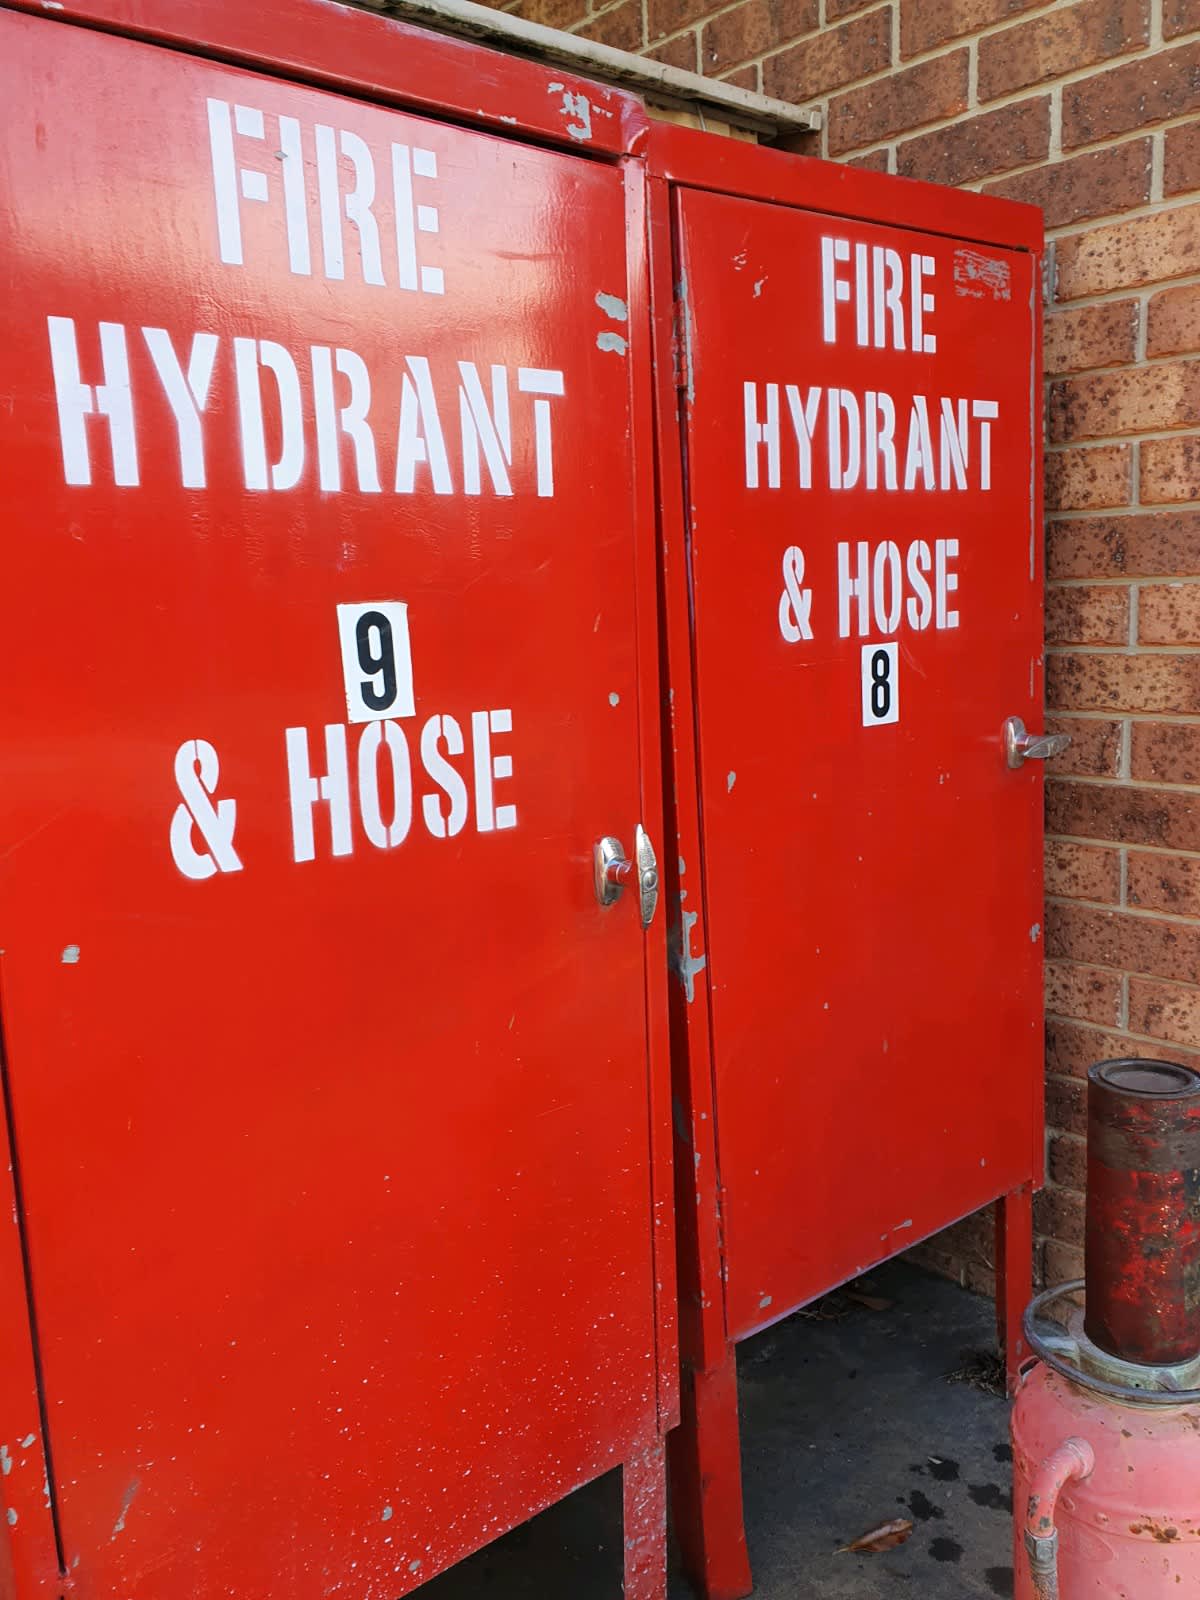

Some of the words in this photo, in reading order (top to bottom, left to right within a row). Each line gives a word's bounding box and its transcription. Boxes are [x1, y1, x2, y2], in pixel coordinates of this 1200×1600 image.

[206, 97, 446, 296] FIRE
[821, 236, 937, 354] FIRE
[47, 315, 565, 498] HYDRANT
[743, 381, 999, 491] HYDRANT
[778, 545, 814, 643] &
[837, 538, 959, 638] HOSE
[355, 611, 398, 711] 9
[871, 649, 891, 718] 8
[169, 738, 244, 880] &
[285, 708, 517, 863] HOSE
